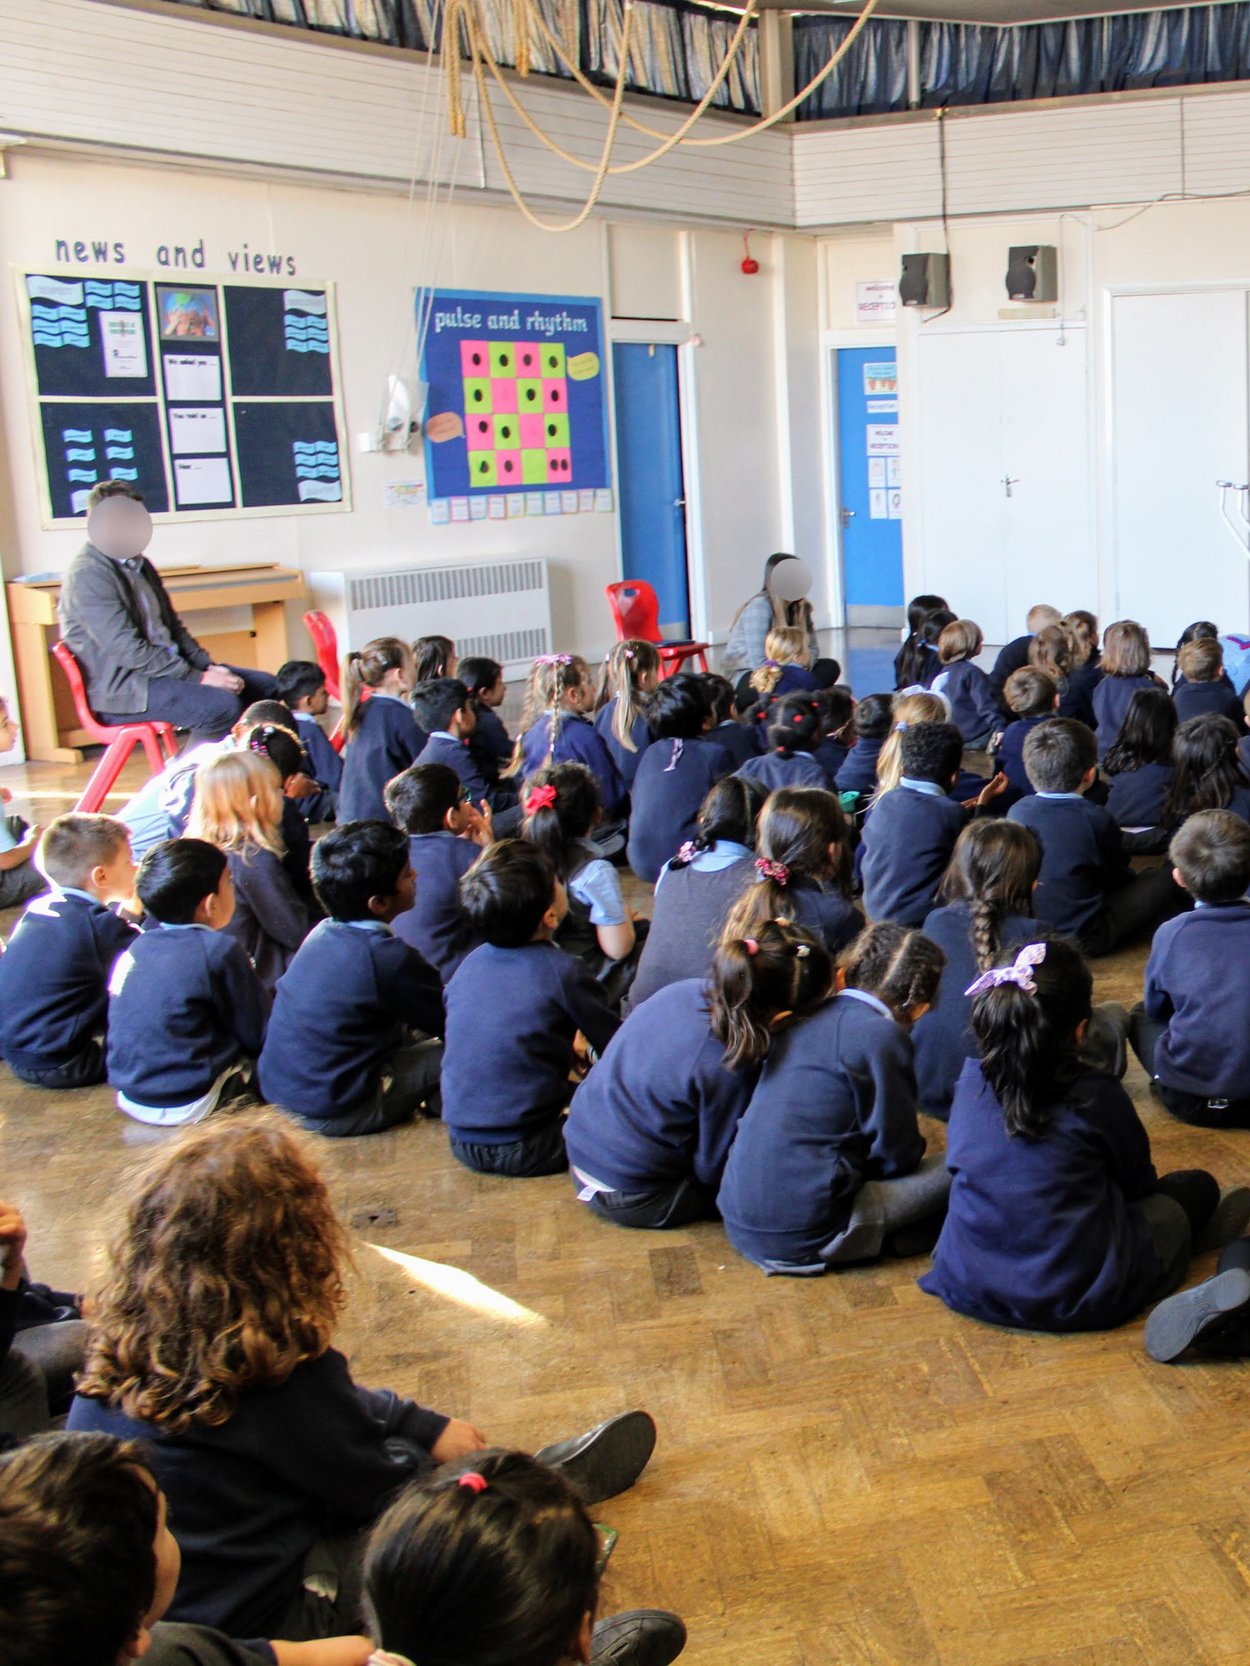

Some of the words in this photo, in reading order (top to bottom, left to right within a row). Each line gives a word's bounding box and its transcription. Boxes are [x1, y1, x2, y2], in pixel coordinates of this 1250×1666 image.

[56, 239, 125, 264] news
[156, 238, 206, 269] and
[227, 243, 297, 276] views
[434, 306, 482, 333] pulse
[487, 308, 521, 330] and
[526, 310, 588, 336] rhythm
